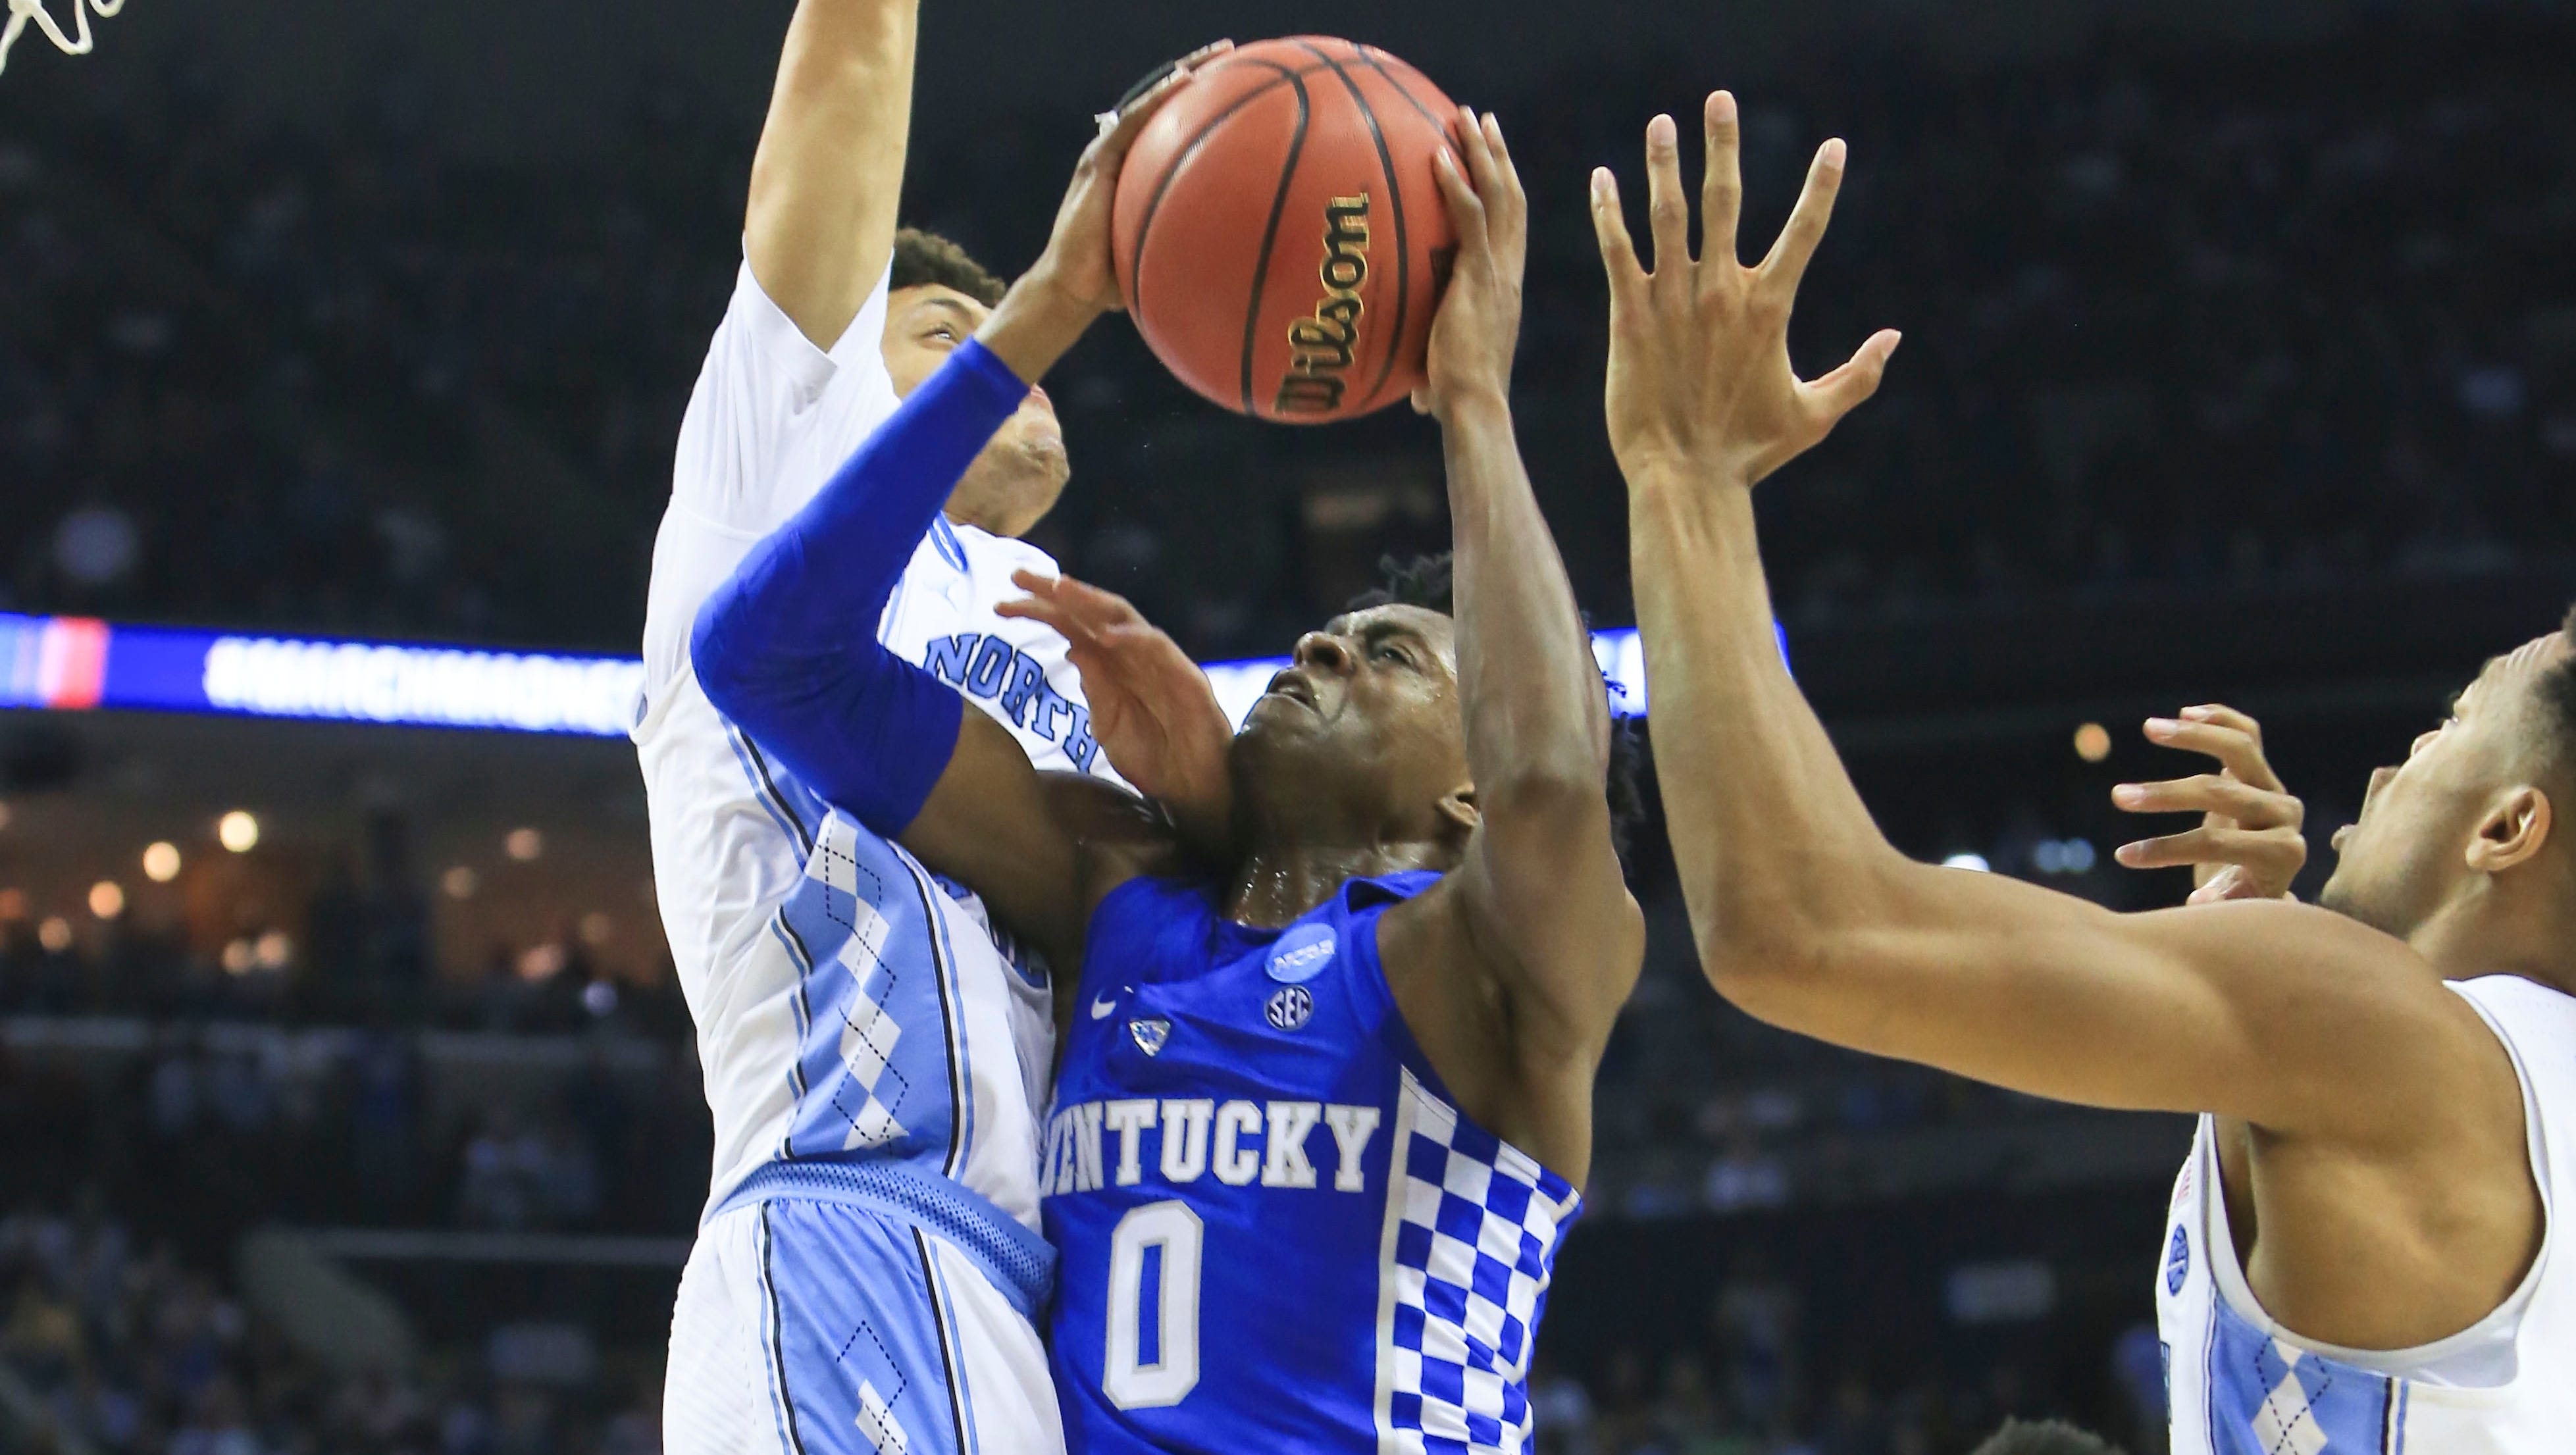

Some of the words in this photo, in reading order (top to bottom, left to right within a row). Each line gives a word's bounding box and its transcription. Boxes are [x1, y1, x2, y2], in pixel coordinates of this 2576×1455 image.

[1274, 191, 1370, 413] Wilson
[923, 632, 1098, 775] NORTH
[1268, 988, 1310, 1027] SEC
[1102, 1199, 1204, 1412] 0
